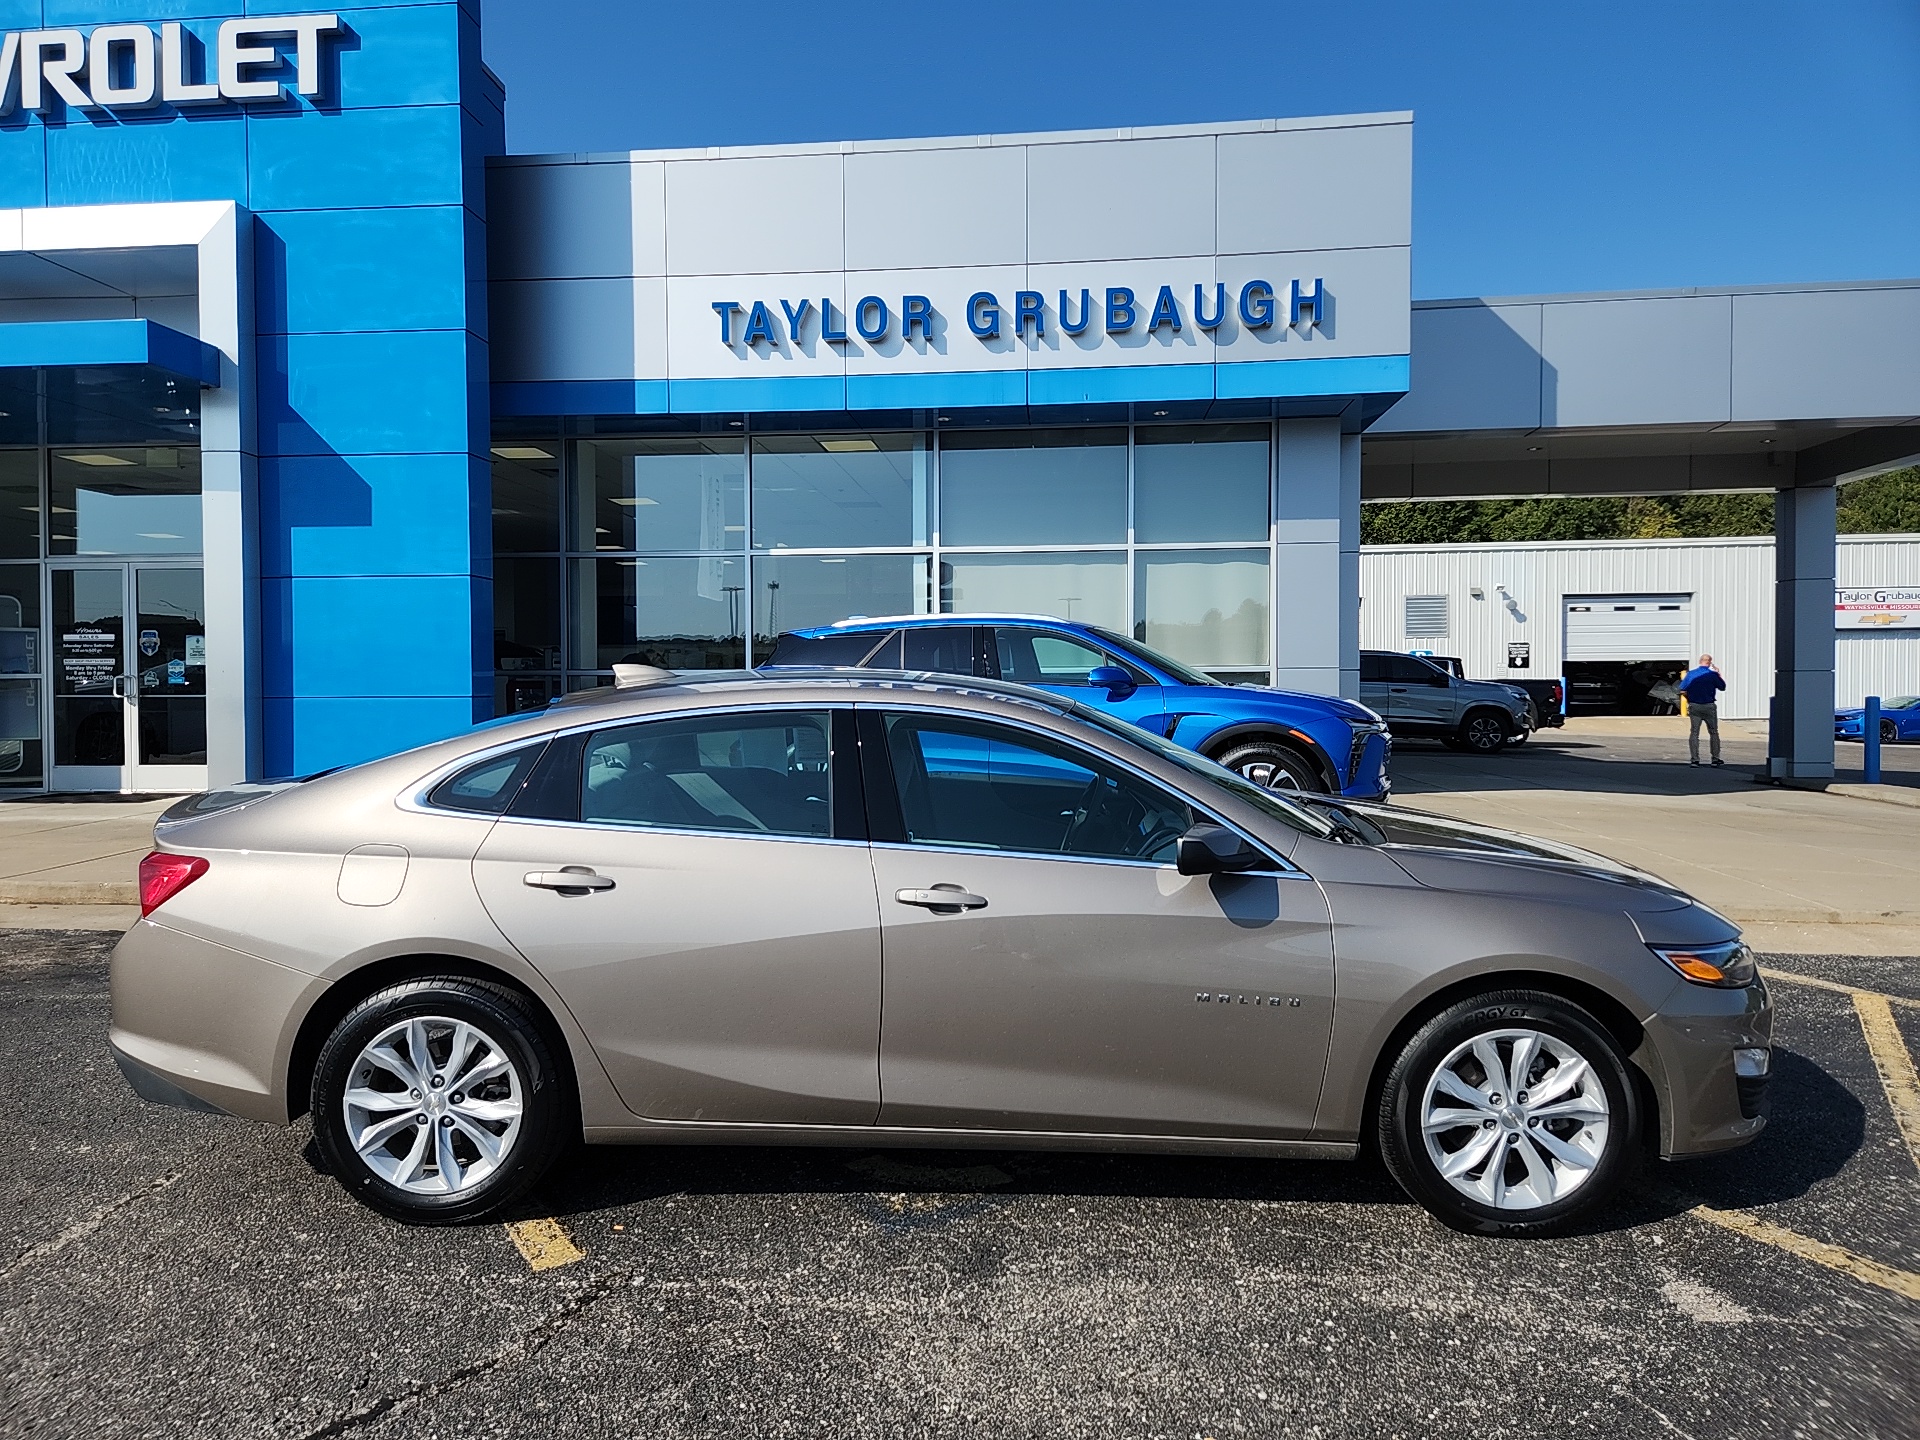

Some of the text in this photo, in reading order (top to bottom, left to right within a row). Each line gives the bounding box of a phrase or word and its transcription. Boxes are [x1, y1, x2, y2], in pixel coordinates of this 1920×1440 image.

[711, 277, 1324, 347] TAYLOR GRUBAUGH
[1834, 590, 1872, 603] Taylor
[1195, 992, 1301, 1008] MALIBU
